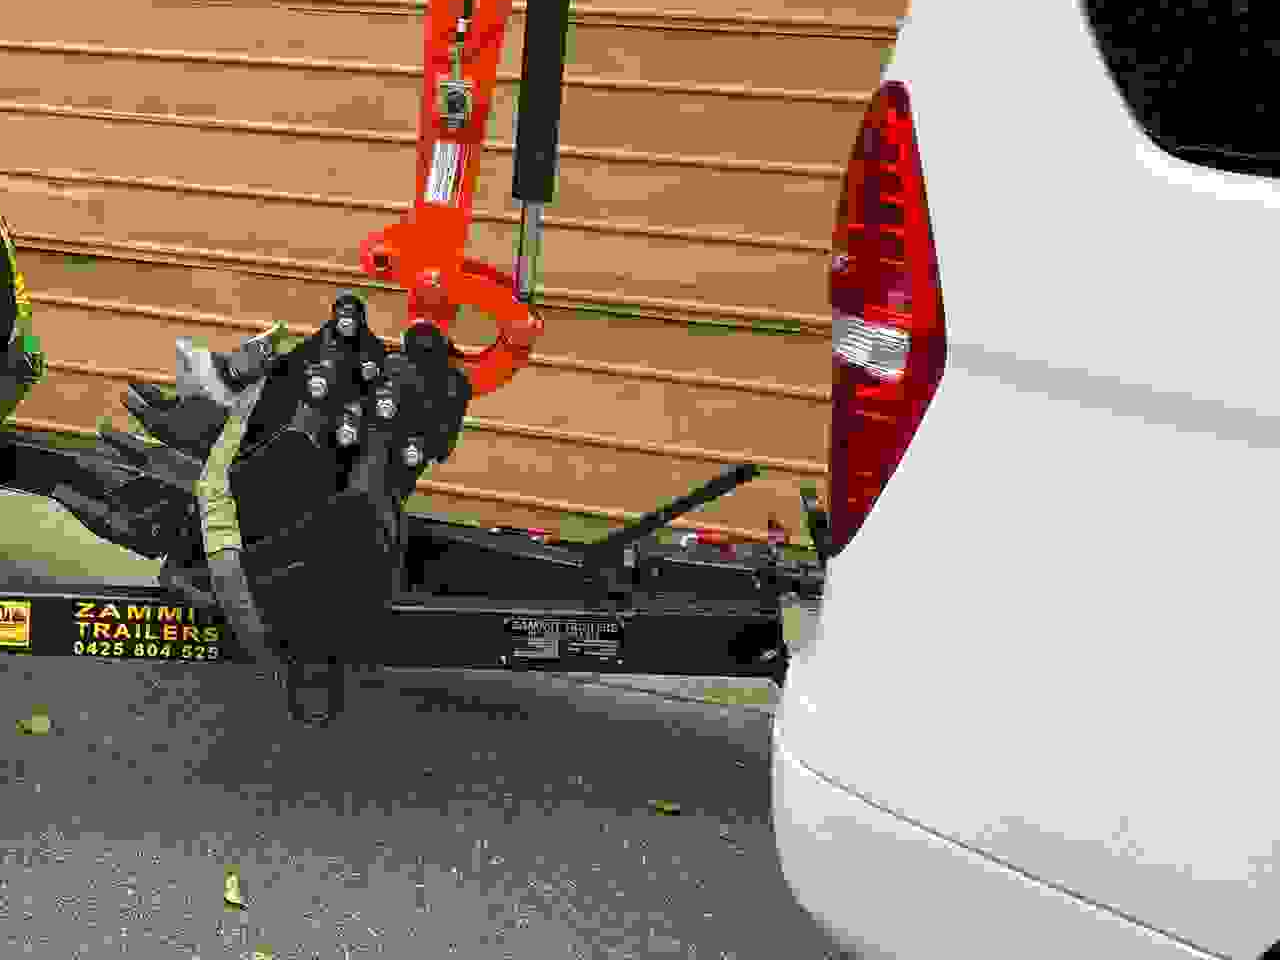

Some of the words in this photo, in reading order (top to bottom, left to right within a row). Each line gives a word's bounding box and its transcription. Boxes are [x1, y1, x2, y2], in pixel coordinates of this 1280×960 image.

[78, 622, 220, 642] TRAILERS
[73, 640, 126, 657] 0425
[133, 641, 173, 658] 804
